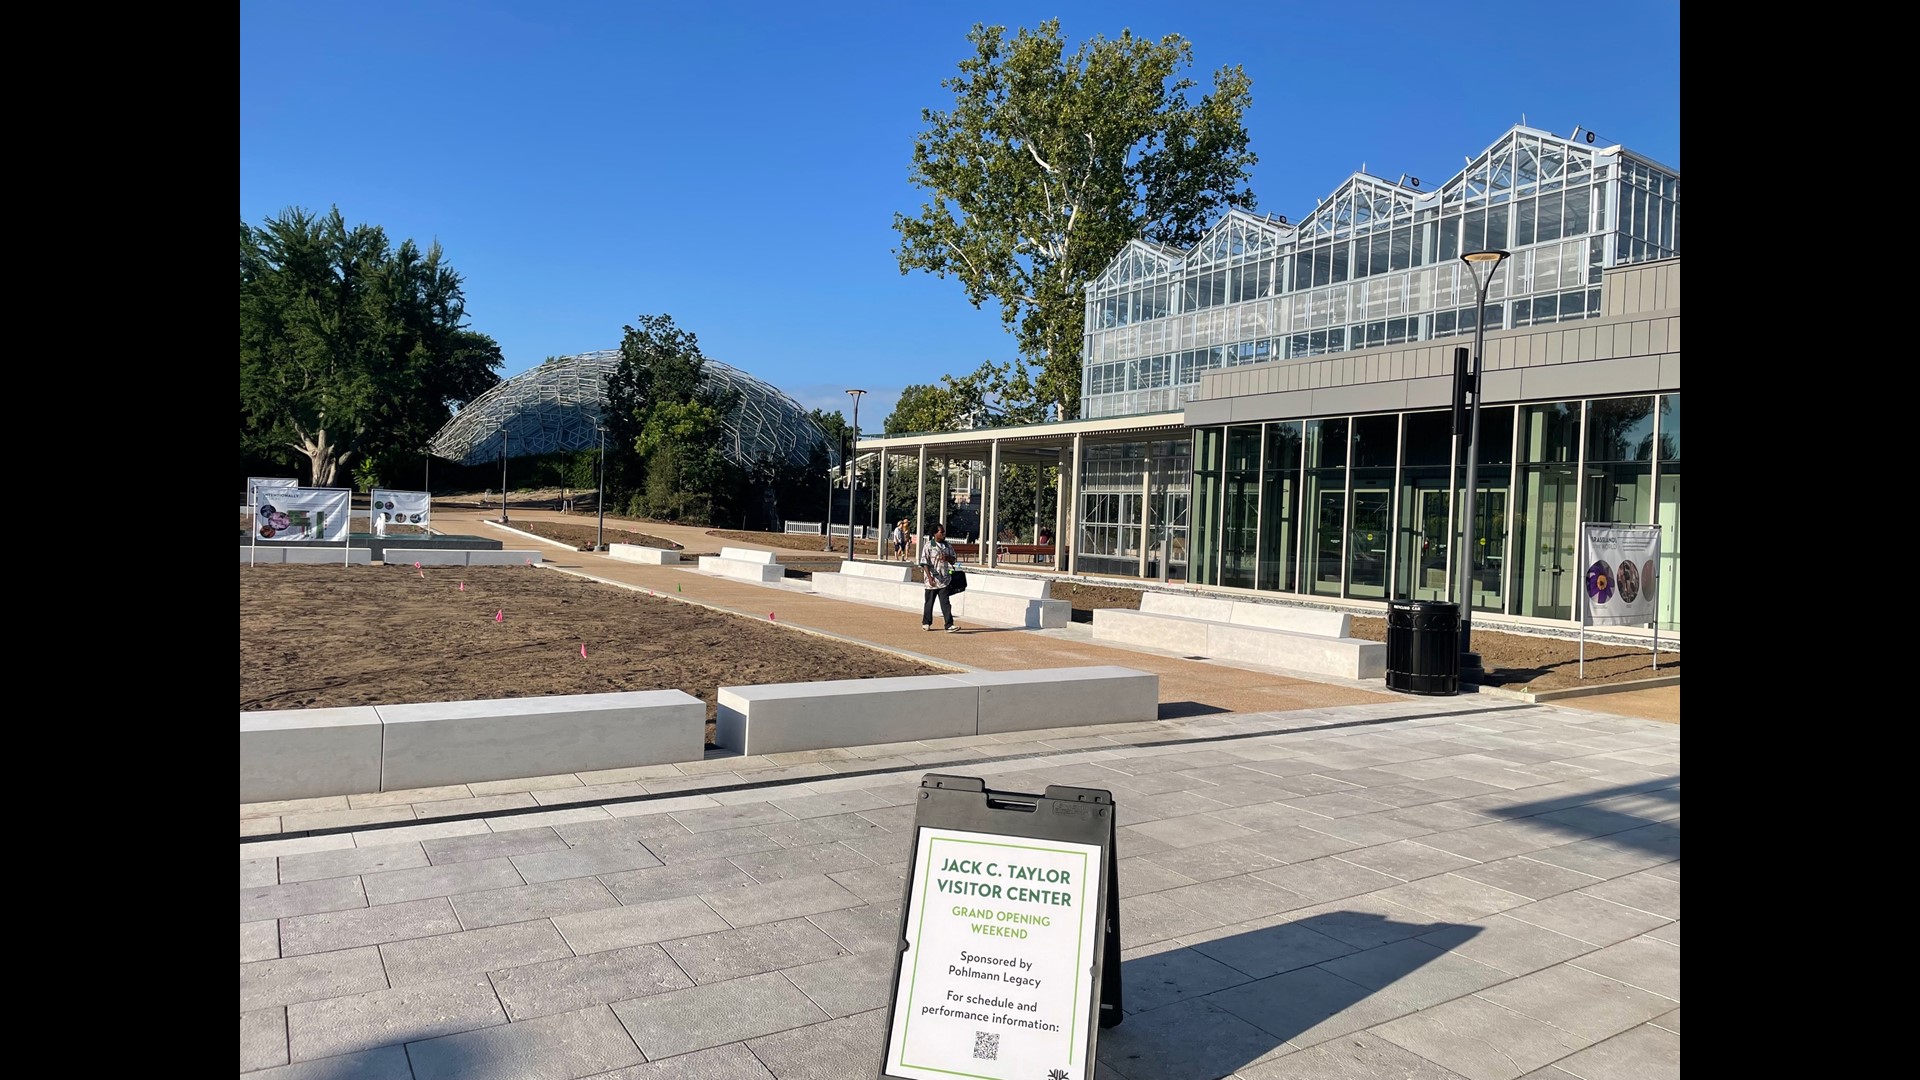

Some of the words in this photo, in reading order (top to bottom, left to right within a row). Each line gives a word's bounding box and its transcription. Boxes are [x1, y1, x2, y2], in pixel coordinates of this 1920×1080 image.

[940, 858, 982, 875] JACK
[986, 863, 1002, 877] C.
[1007, 865, 1071, 884] TAYLOR
[937, 879, 1001, 898] VISITOR
[1006, 887, 1071, 906] CENTER
[952, 906, 993, 919] GRAND
[997, 911, 1050, 926] OPENING
[971, 923, 1028, 939] WEEKEND
[960, 951, 1017, 968] Sponsored
[1019, 958, 1033, 971] by
[948, 965, 1000, 981] Pohlmann
[1003, 972, 1041, 988] Legacy
[947, 990, 964, 1002] For
[966, 993, 1014, 1009] schedule
[1017, 1002, 1038, 1012] and
[921, 1005, 989, 1022] performance
[992, 1012, 1060, 1032] information:
